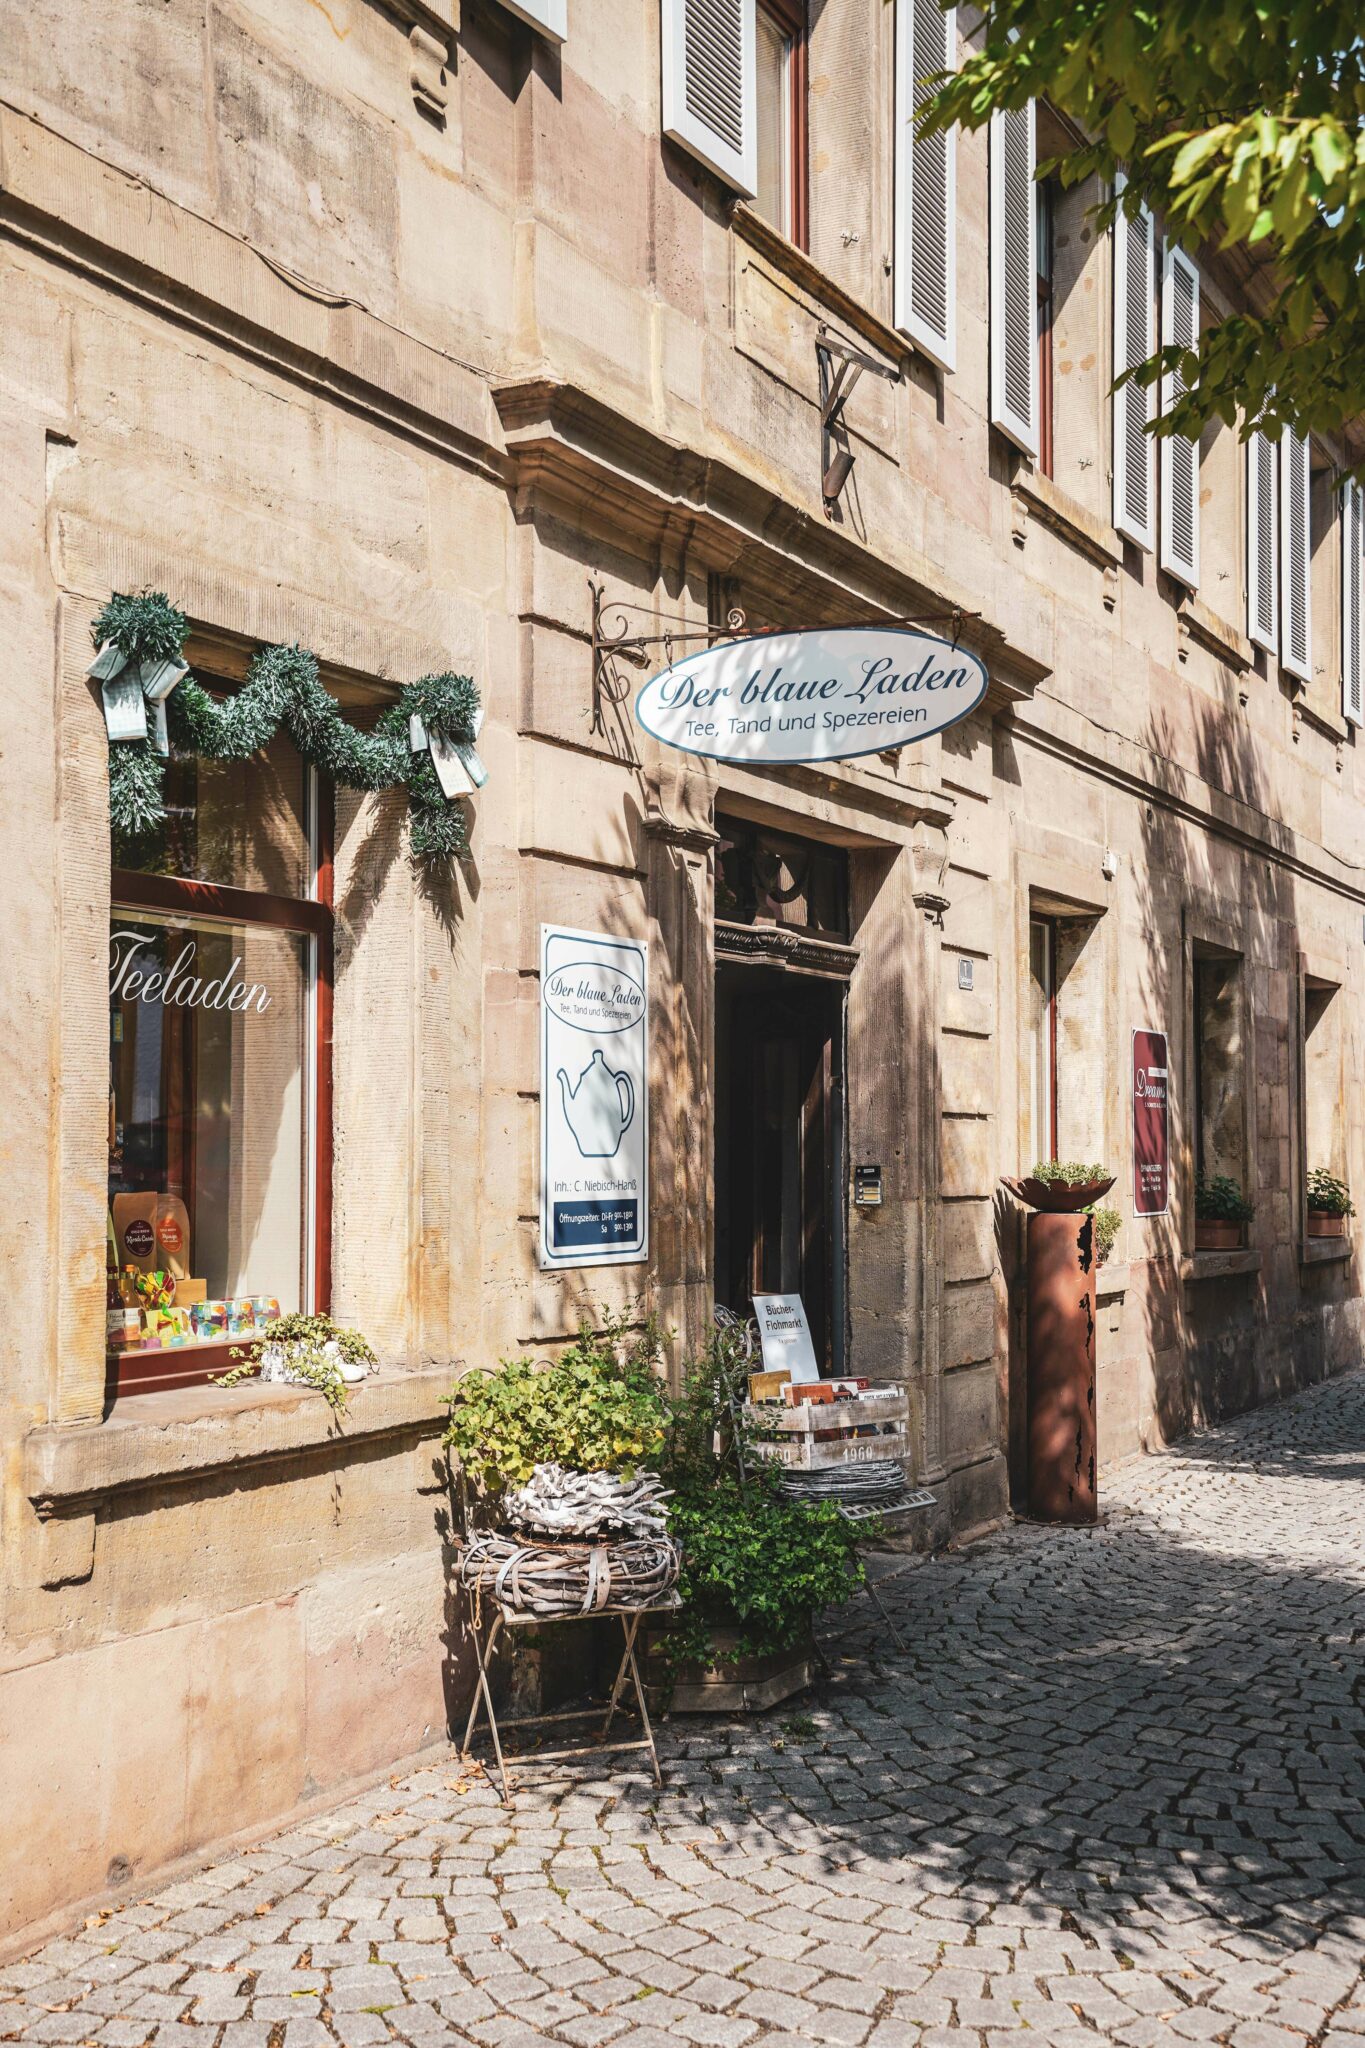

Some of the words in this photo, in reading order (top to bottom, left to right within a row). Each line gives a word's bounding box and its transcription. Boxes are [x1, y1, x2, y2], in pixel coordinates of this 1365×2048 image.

[658, 672, 734, 710] Der
[740, 667, 843, 704] blaue
[844, 655, 974, 704] Laden
[685, 720, 719, 737] Tee,
[729, 715, 771, 734] Tand
[778, 712, 815, 731] und
[822, 706, 928, 733] Spezereien
[110, 931, 272, 1013] Teeladen
[550, 976, 574, 997] Der
[577, 980, 606, 1002] blaue
[608, 984, 641, 1007] Laden
[560, 1003, 571, 1014] Tee,
[573, 1004, 587, 1015] Tand
[588, 1007, 600, 1016] und
[601, 1008, 632, 1020] Spezereien
[554, 1181, 572, 1193] Inh.:
[574, 1180, 582, 1192] C.
[584, 1178, 637, 1192] Niebisch-Hanß
[558, 1212, 599, 1224] Öffnungszeiten:
[601, 1211, 614, 1221] Di-Fr
[601, 1224, 608, 1234] Sa
[765, 1304, 795, 1316] Bücher-
[765, 1318, 803, 1331] Flohmarkt
[842, 1446, 873, 1463] 1960
